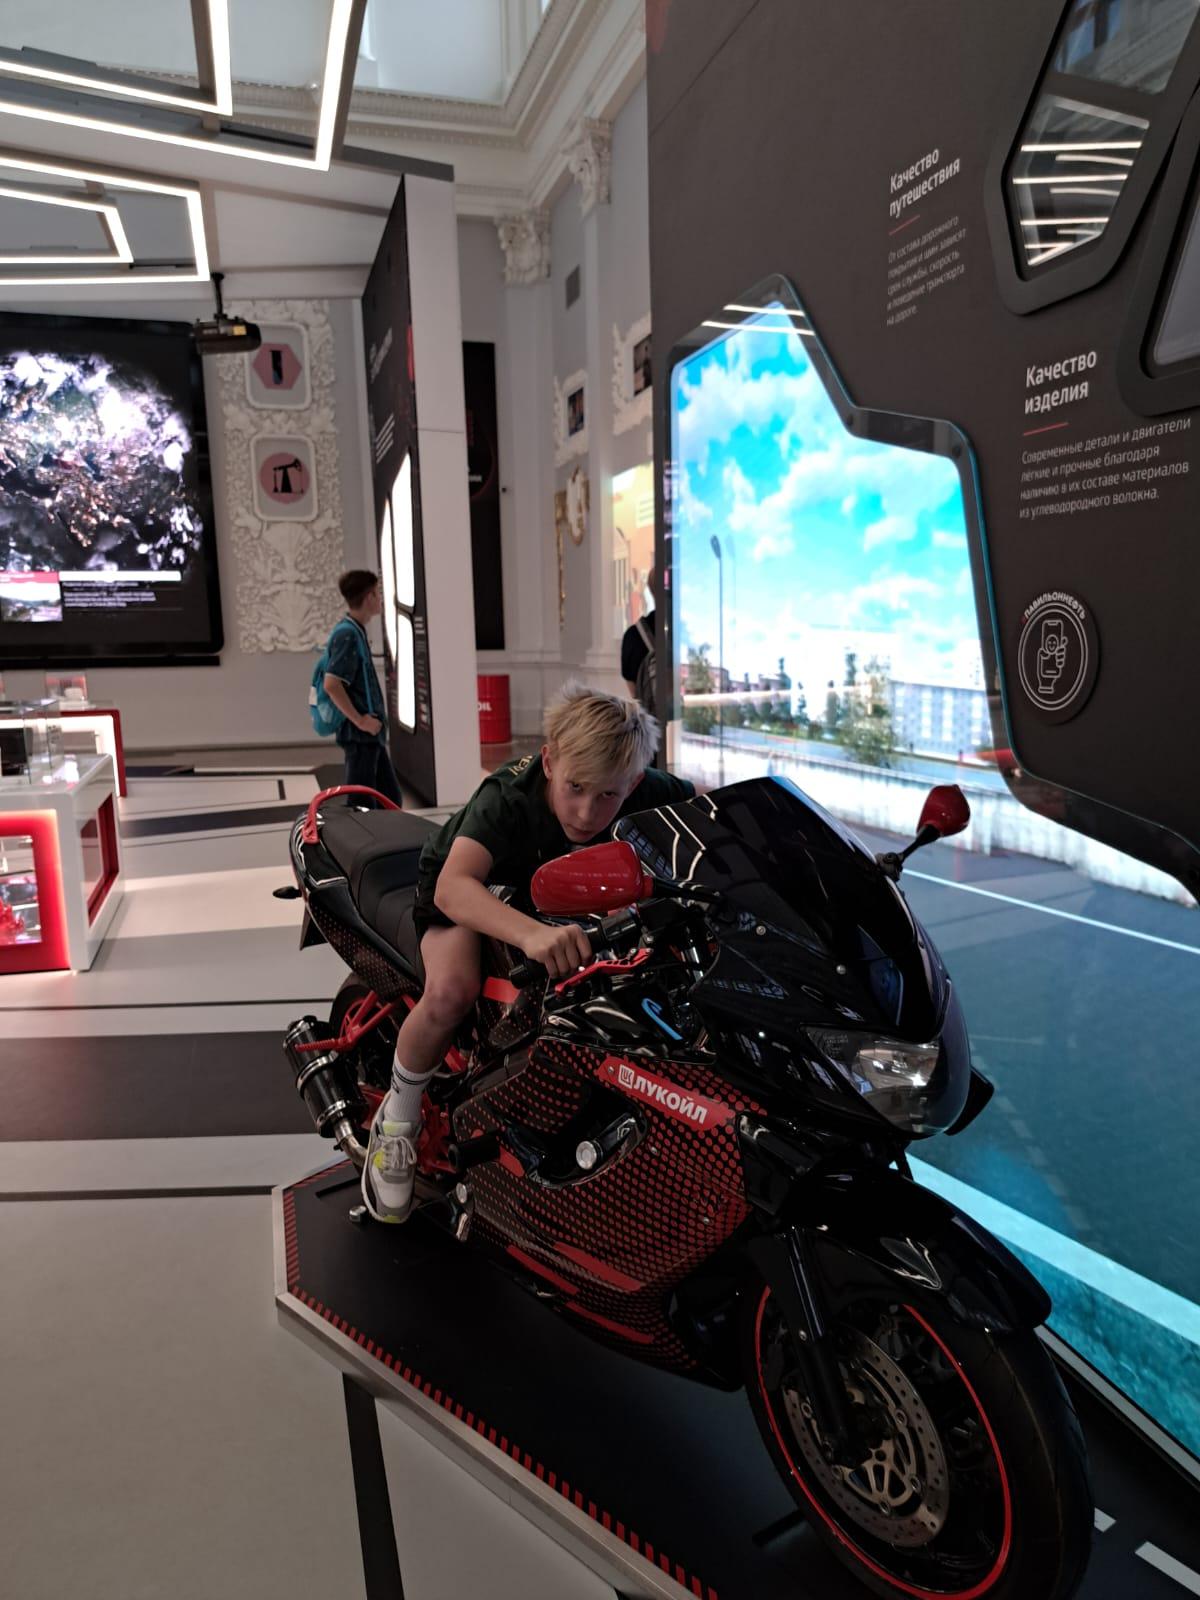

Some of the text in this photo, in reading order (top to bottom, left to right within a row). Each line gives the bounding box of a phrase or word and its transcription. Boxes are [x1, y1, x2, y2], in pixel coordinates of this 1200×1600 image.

[889, 158, 961, 218] путешествия
[890, 148, 939, 194] Качество
[1025, 350, 1098, 388] Качество
[1024, 381, 1089, 414] изделия
[1021, 417, 1192, 465] Современные детали и двигатели
[1052, 465, 1058, 476] и
[1059, 457, 1102, 476] прочные
[1104, 445, 1160, 467] благодаря
[1020, 461, 1190, 500] наличию в их составе материалов
[1019, 487, 1160, 521] из углеводородного волокна.
[633, 1076, 708, 1124] ЛУКОЙЛ
